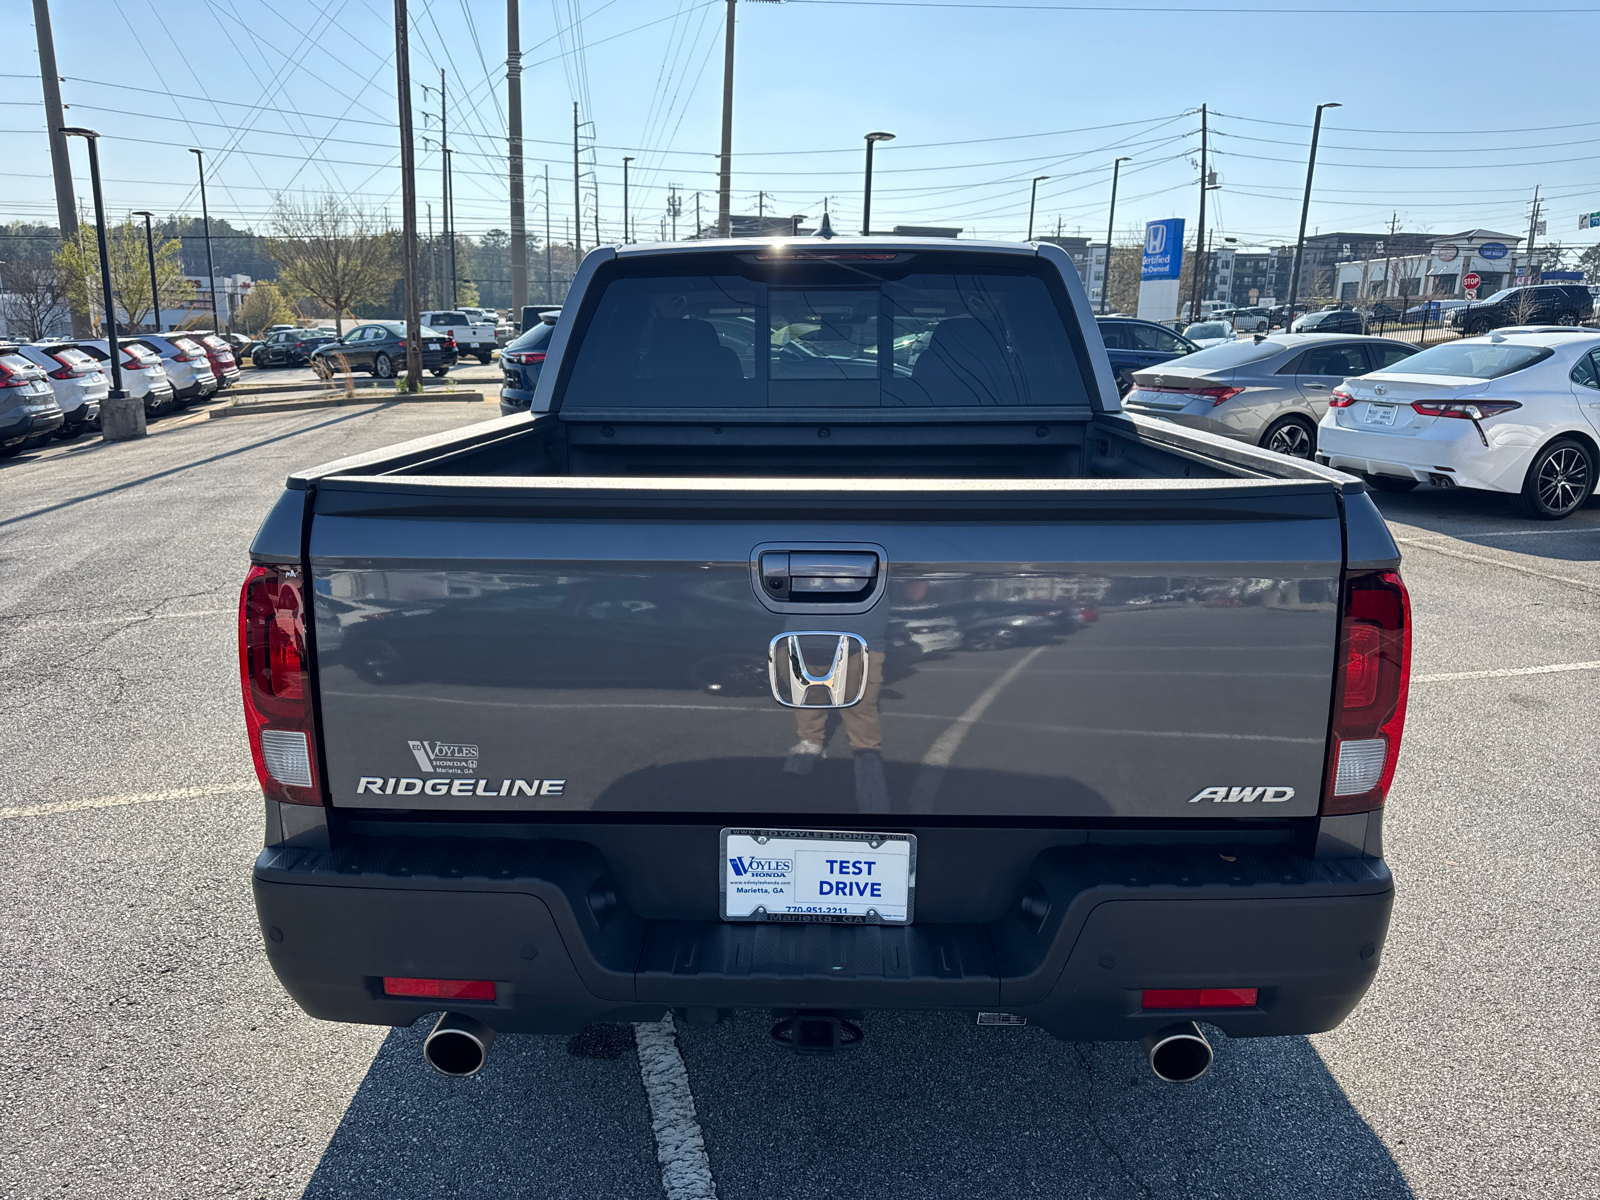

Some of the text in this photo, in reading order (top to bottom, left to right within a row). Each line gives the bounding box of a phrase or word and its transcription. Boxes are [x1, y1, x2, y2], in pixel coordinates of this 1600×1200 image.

[422, 741, 478, 760] VOYLES
[436, 767, 463, 775] Marietta,
[356, 776, 567, 797] RIDGELINE
[1188, 786, 1295, 803] AWD
[736, 856, 791, 875] VOYLES
[825, 859, 877, 876] TEST
[736, 887, 771, 895] Marietta,
[819, 880, 882, 898] DRIVE
